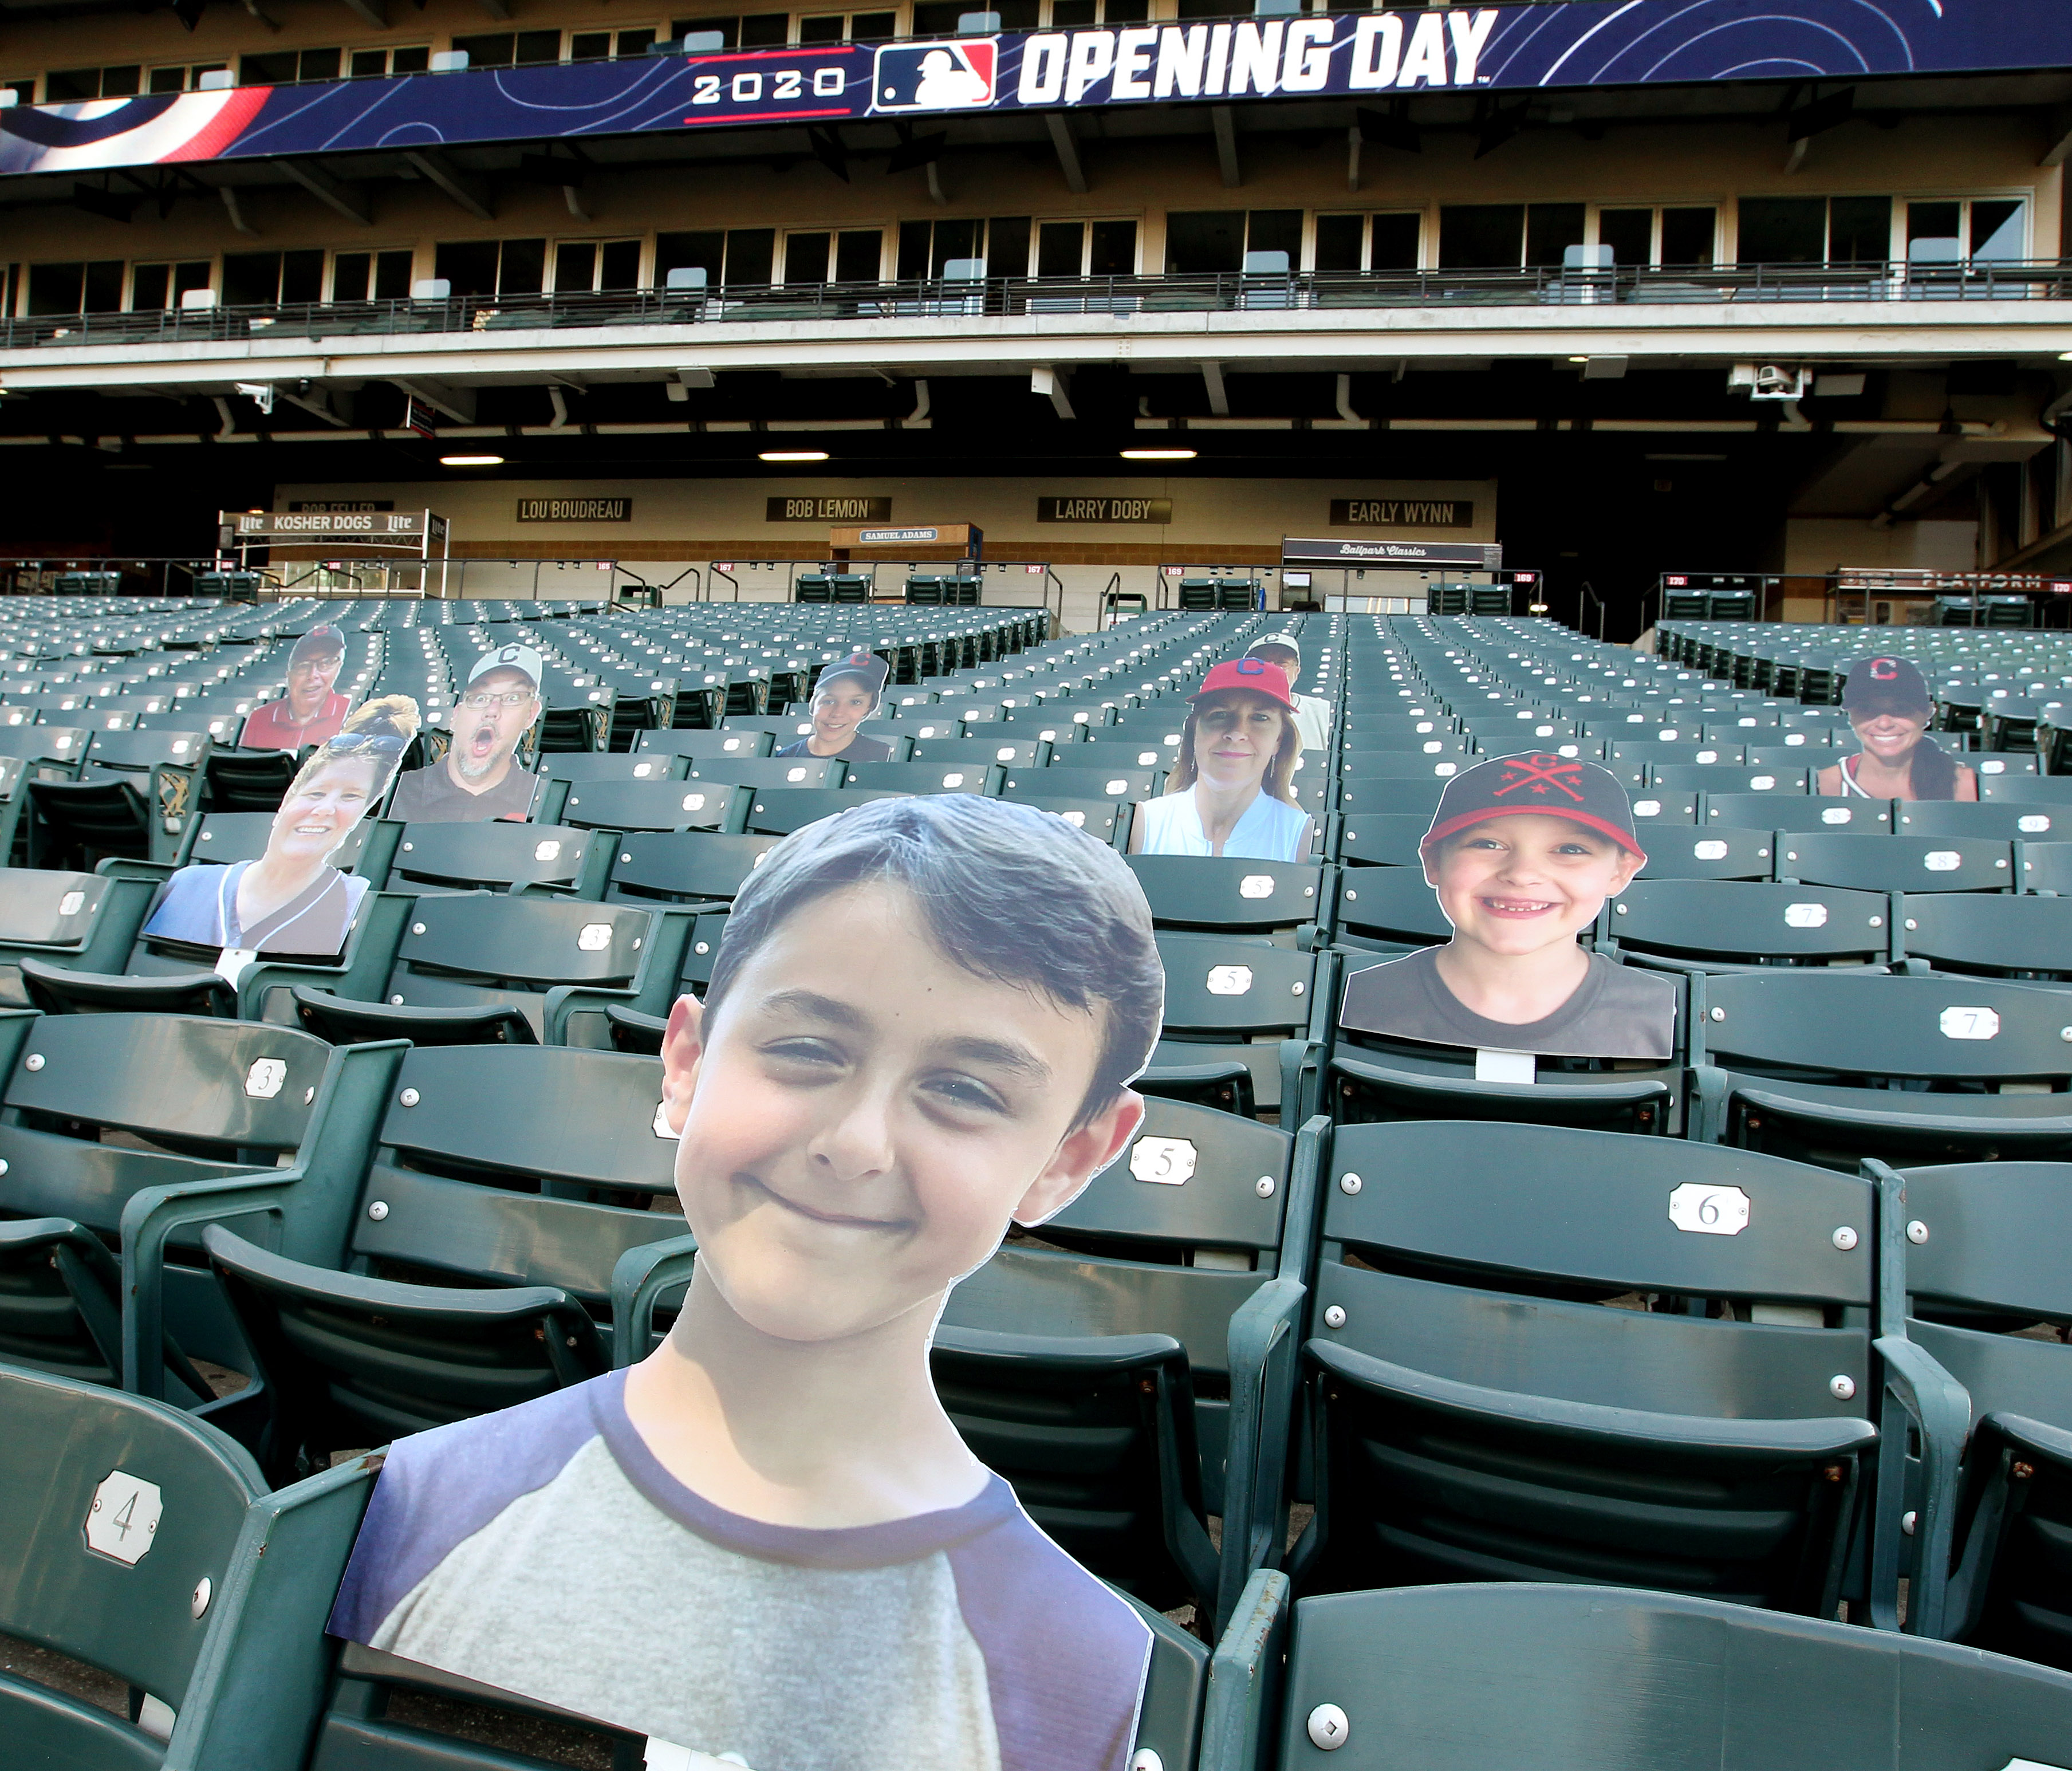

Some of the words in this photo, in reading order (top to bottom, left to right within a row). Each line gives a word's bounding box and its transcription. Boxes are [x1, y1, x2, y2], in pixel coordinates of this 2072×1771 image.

[1017, 19, 1335, 104] OPENING
[1349, 9, 1499, 92] DAY
[692, 67, 845, 105] 2020
[522, 500, 547, 519] LOU
[552, 500, 624, 518] BOUDREAU
[786, 499, 813, 518] BOB
[818, 499, 869, 518] LEMON
[1055, 500, 1106, 519] LARRY
[1111, 500, 1151, 519] DOBY
[1348, 502, 1399, 522] EARLY
[1404, 503, 1454, 523] WYNN
[239, 516, 264, 533] Lite
[274, 516, 331, 530] KOSHER
[334, 515, 372, 529] DOGS
[387, 515, 412, 532] Lite
[865, 531, 900, 540] SAMUEL
[901, 530, 932, 539] ADAMS
[1340, 544, 1385, 557] Ballpark
[1386, 546, 1427, 557] Classics
[1168, 568, 1183, 576] 169
[1517, 574, 1532, 582] 169
[1669, 576, 1684, 585] 170
[498, 646, 521, 664] C
[849, 653, 871, 666] C
[1236, 658, 1265, 675] C
[1869, 658, 1898, 680] C
[1530, 754, 1558, 767] C
[1708, 844, 1717, 856] 7
[1937, 855, 1948, 868] 8
[1252, 880, 1263, 895] 5
[1802, 908, 1813, 923] 7
[590, 929, 599, 946] 3
[1223, 970, 1238, 989] 5
[1964, 1013, 1978, 1033] 7
[258, 1065, 273, 1090] 3
[1154, 1147, 1175, 1176] 5
[1698, 1194, 1720, 1225] 6
[112, 1490, 139, 1542] 4
